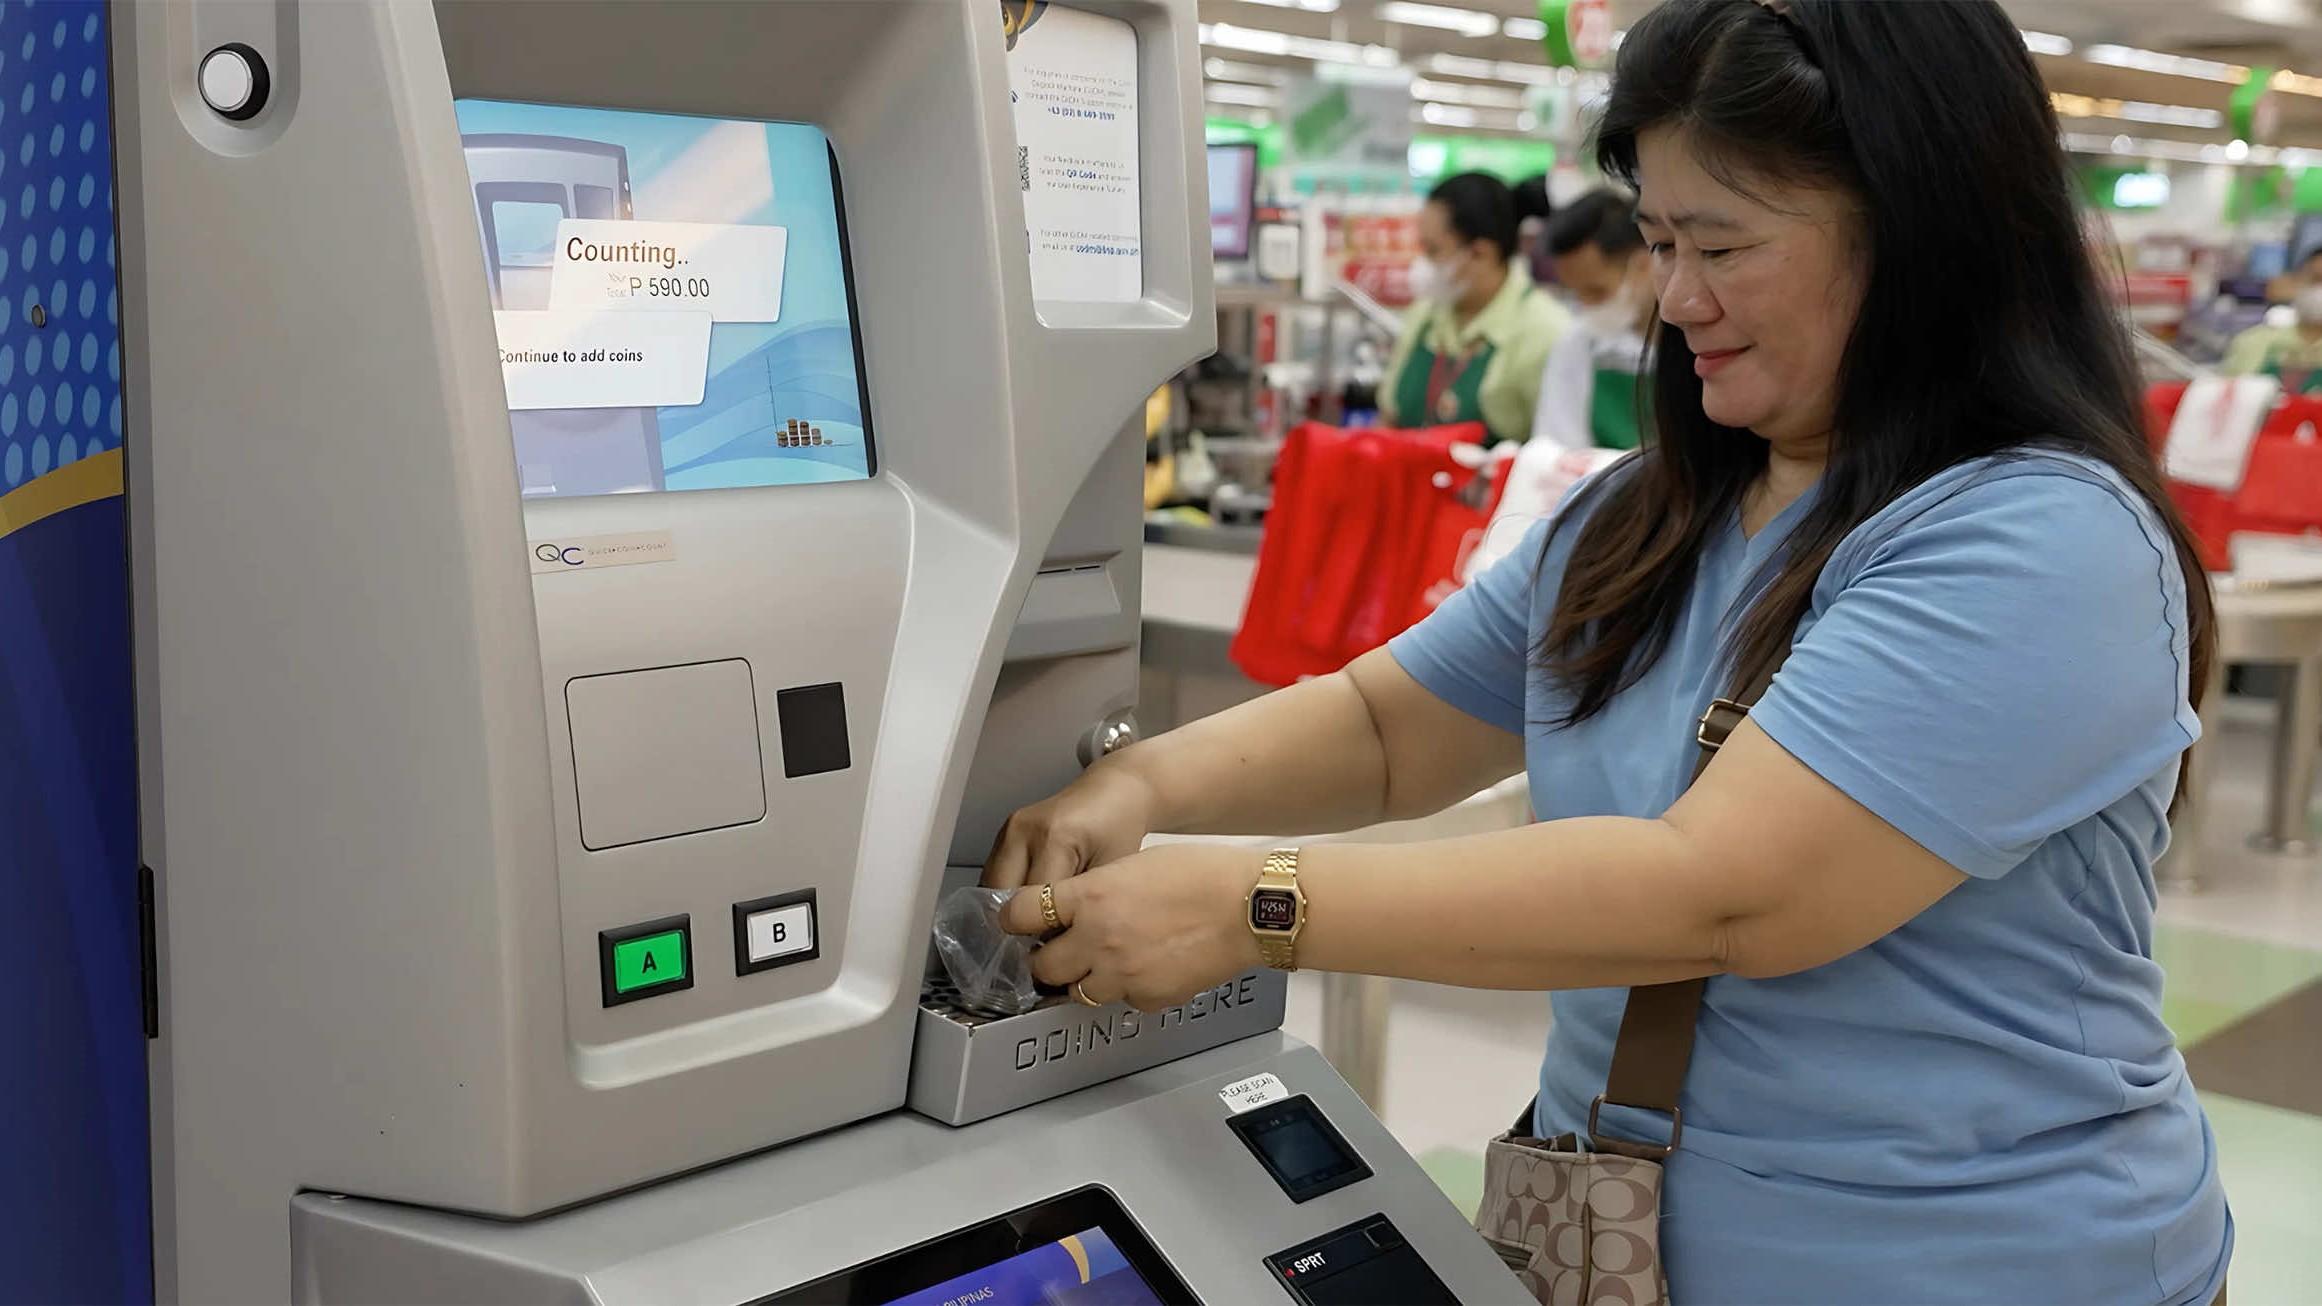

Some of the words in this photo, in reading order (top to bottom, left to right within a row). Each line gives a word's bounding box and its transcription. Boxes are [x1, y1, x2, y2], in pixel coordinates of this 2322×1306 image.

[566, 236, 689, 269] Counting..
[629, 277, 642, 297] P
[649, 277, 710, 298] 590.00
[563, 350, 576, 362] to
[580, 348, 605, 362] add
[609, 348, 644, 362] coins
[535, 543, 585, 566] QC
[772, 922, 787, 944] B
[641, 951, 657, 974] A
[1015, 1009, 1143, 1072] COINS
[1160, 975, 1257, 1030] HERE
[1293, 1252, 1327, 1274] SPRT
